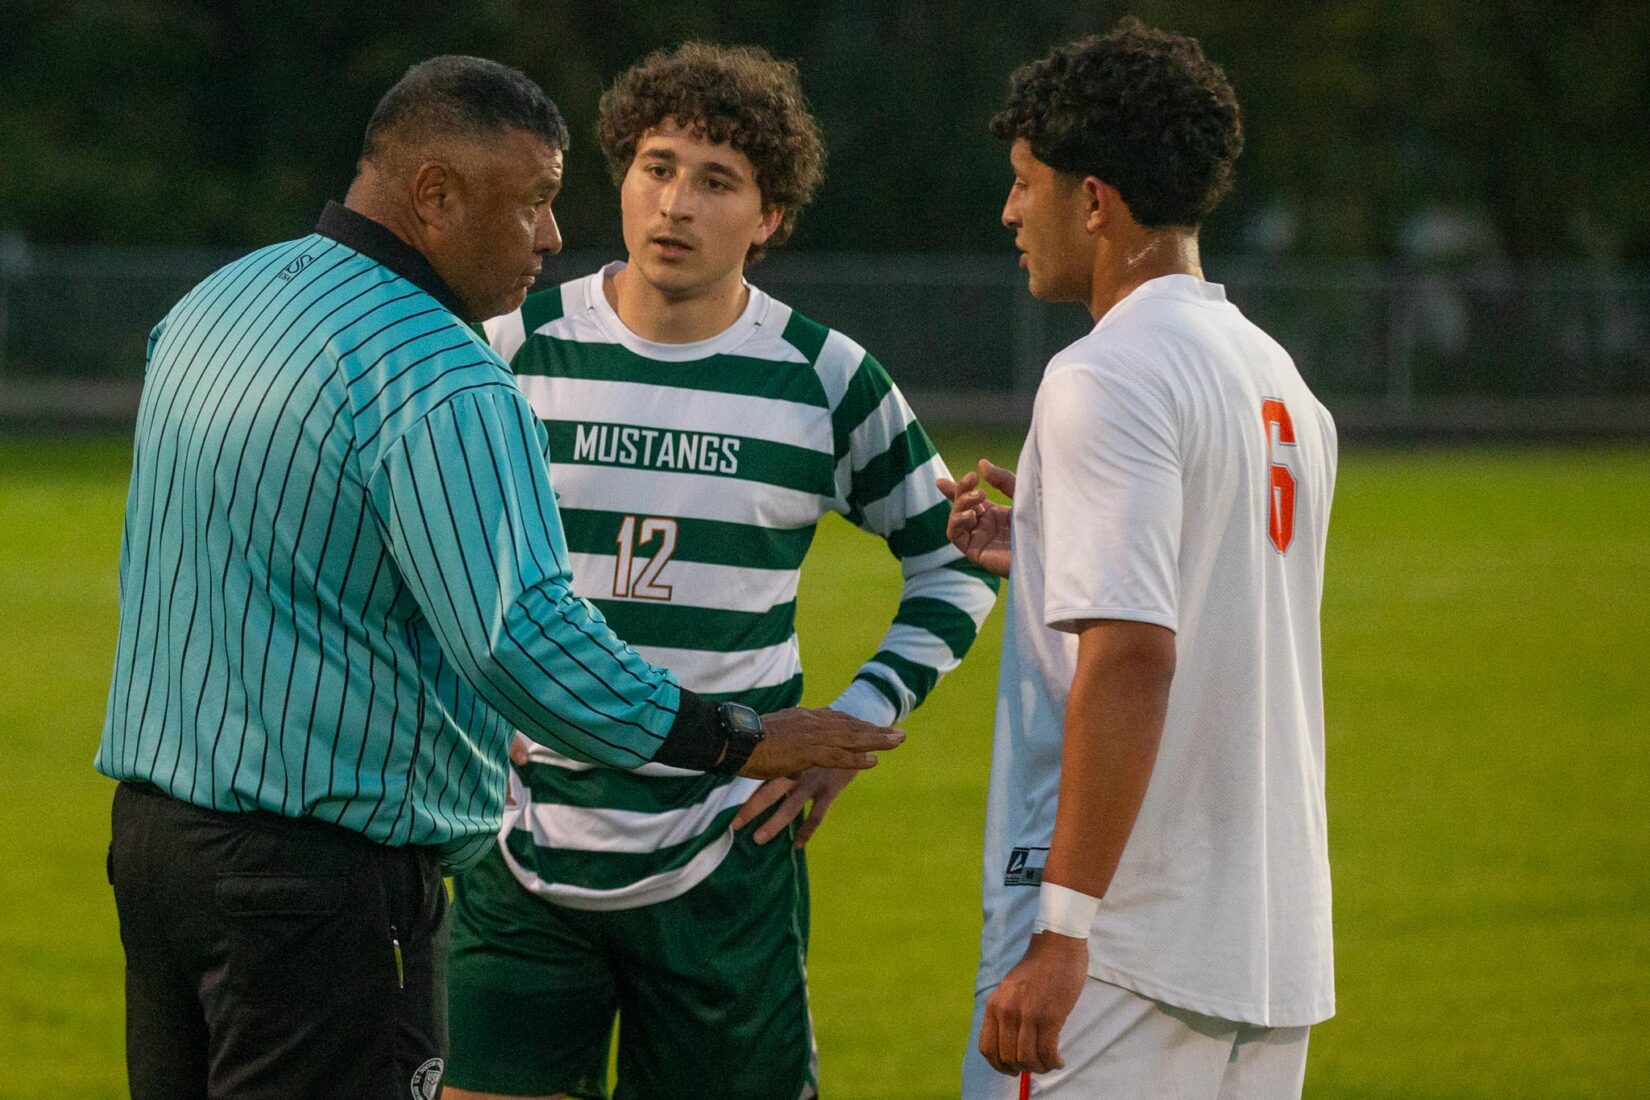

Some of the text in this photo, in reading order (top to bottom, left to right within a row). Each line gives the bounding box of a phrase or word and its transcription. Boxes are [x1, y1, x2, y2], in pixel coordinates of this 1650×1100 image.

[573, 424, 740, 474] MUSTANGS
[1261, 395, 1298, 557] 6
[612, 514, 679, 602] 12
